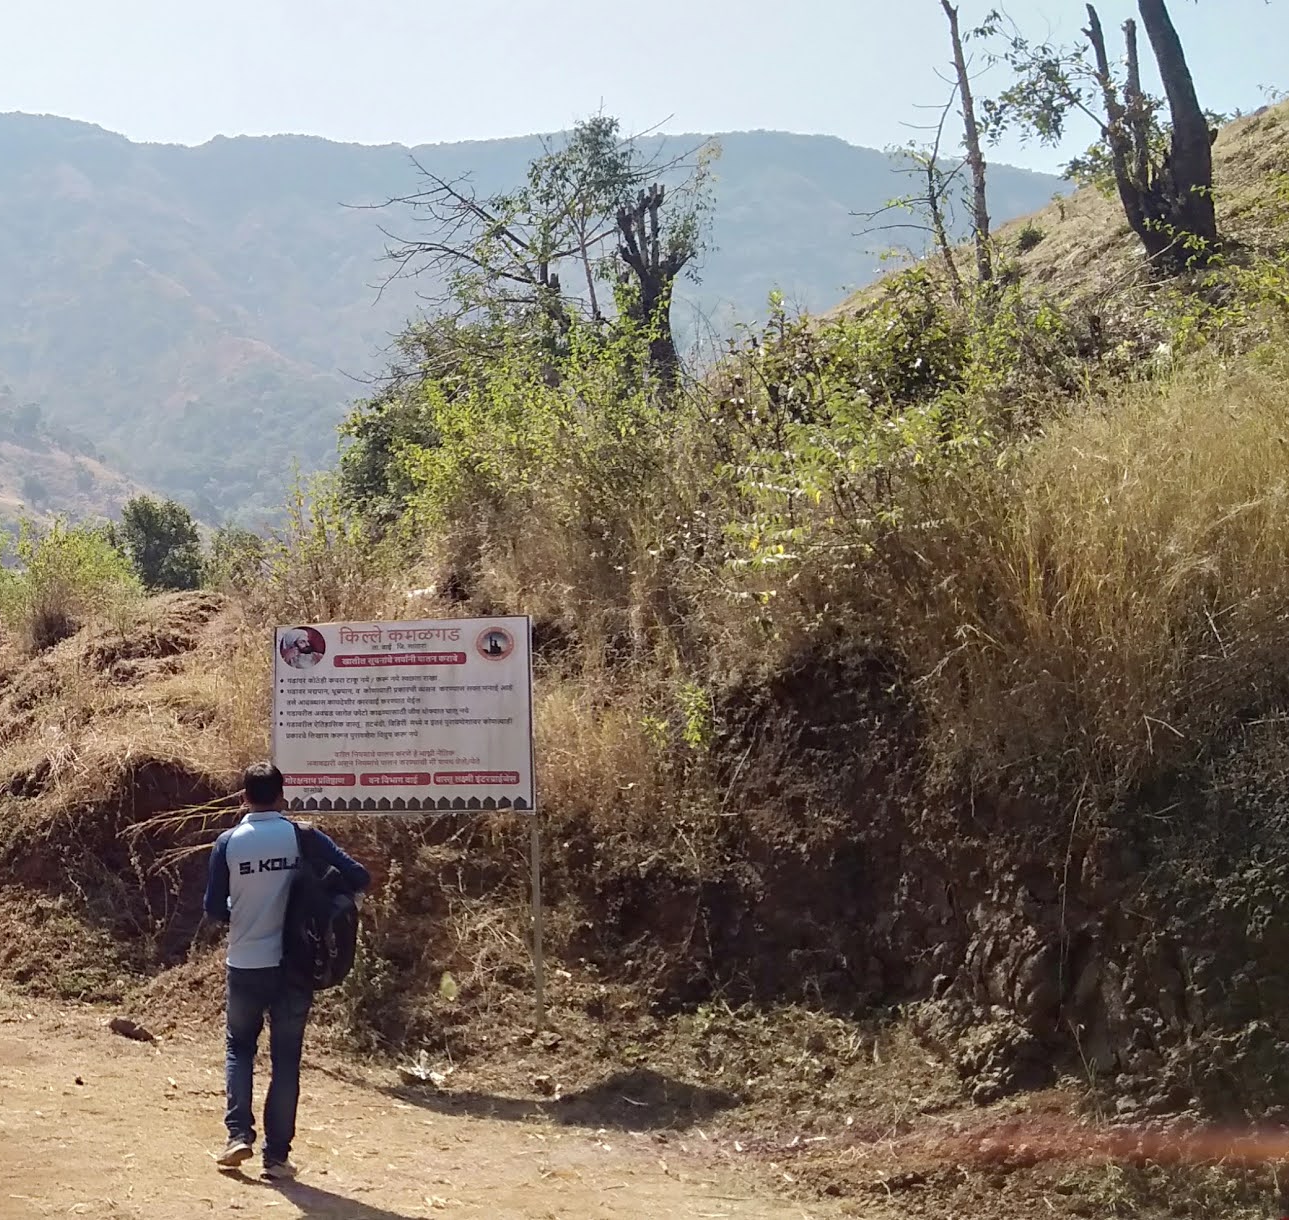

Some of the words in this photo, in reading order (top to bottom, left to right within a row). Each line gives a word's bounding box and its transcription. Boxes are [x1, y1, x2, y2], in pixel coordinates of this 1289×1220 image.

[339, 625, 383, 644] किल्ले
[387, 628, 461, 642] कमळगड
[239, 861, 255, 875] S.
